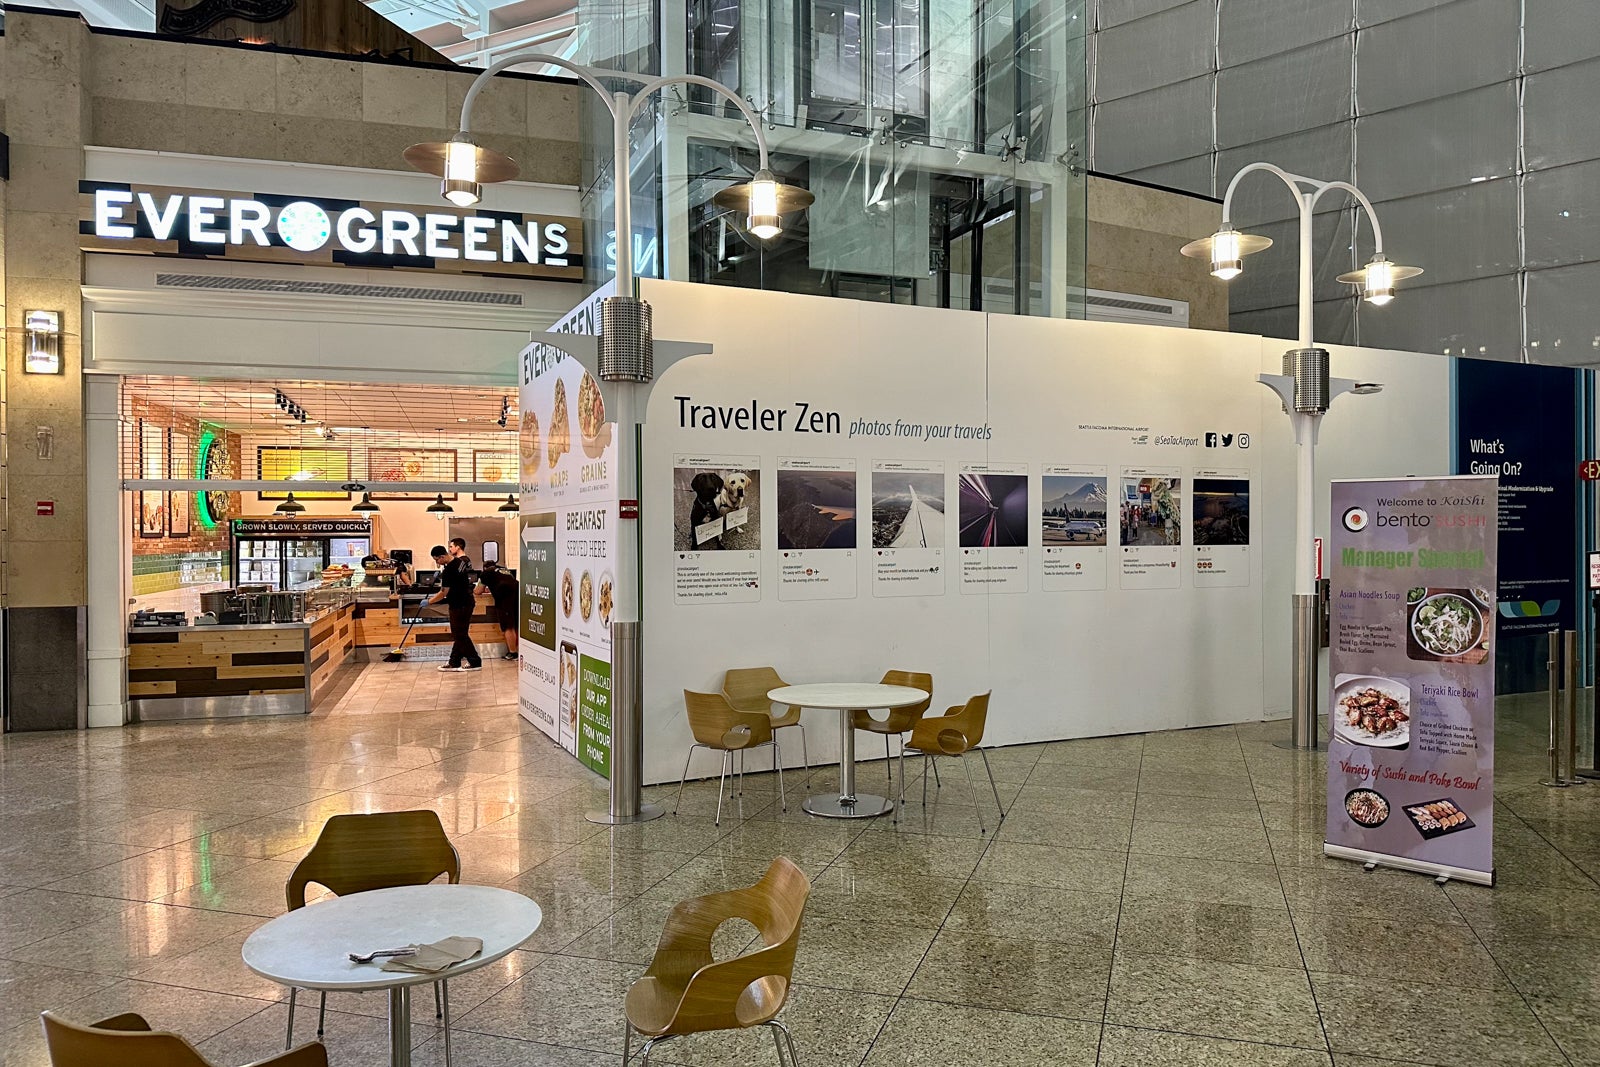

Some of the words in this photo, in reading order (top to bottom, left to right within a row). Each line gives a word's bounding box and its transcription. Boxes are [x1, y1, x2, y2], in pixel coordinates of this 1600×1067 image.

[674, 396, 787, 432] Traveler
[794, 402, 841, 434] Zen
[849, 418, 892, 439] photos
[894, 419, 922, 438] from
[924, 424, 951, 442] your
[954, 423, 992, 440] travels
[1154, 436, 1198, 448] @SeaTacAirport
[1470, 438, 1504, 454] What's
[1470, 460, 1500, 475] Going
[1502, 462, 1522, 476] On?
[1377, 498, 1424, 507] Welcome
[1440, 494, 1486, 506] KoiShi
[566, 510, 606, 530] BREAKFAST
[1376, 512, 1430, 527] bento
[1435, 514, 1486, 527] SUSHI
[567, 540, 588, 557] SERVED
[589, 540, 606, 558] HERE
[1342, 547, 1414, 570] Manager
[1340, 590, 1356, 598] Asian
[1359, 590, 1382, 599] Noodles
[1385, 591, 1400, 602] Soup
[586, 688, 595, 703] OUR
[596, 693, 607, 708] APP
[1422, 684, 1446, 697] Teriyaki
[1448, 686, 1460, 697] Rice
[1462, 688, 1479, 698] Bowl
[583, 723, 595, 740] FROM
[587, 744, 604, 764] PHONE
[1339, 760, 1370, 781] Variety
[1372, 764, 1382, 780] of
[1382, 767, 1406, 780] Sushi
[1409, 770, 1429, 784] and
[1429, 773, 1451, 787] Poke
[1453, 777, 1481, 790] Bowl
